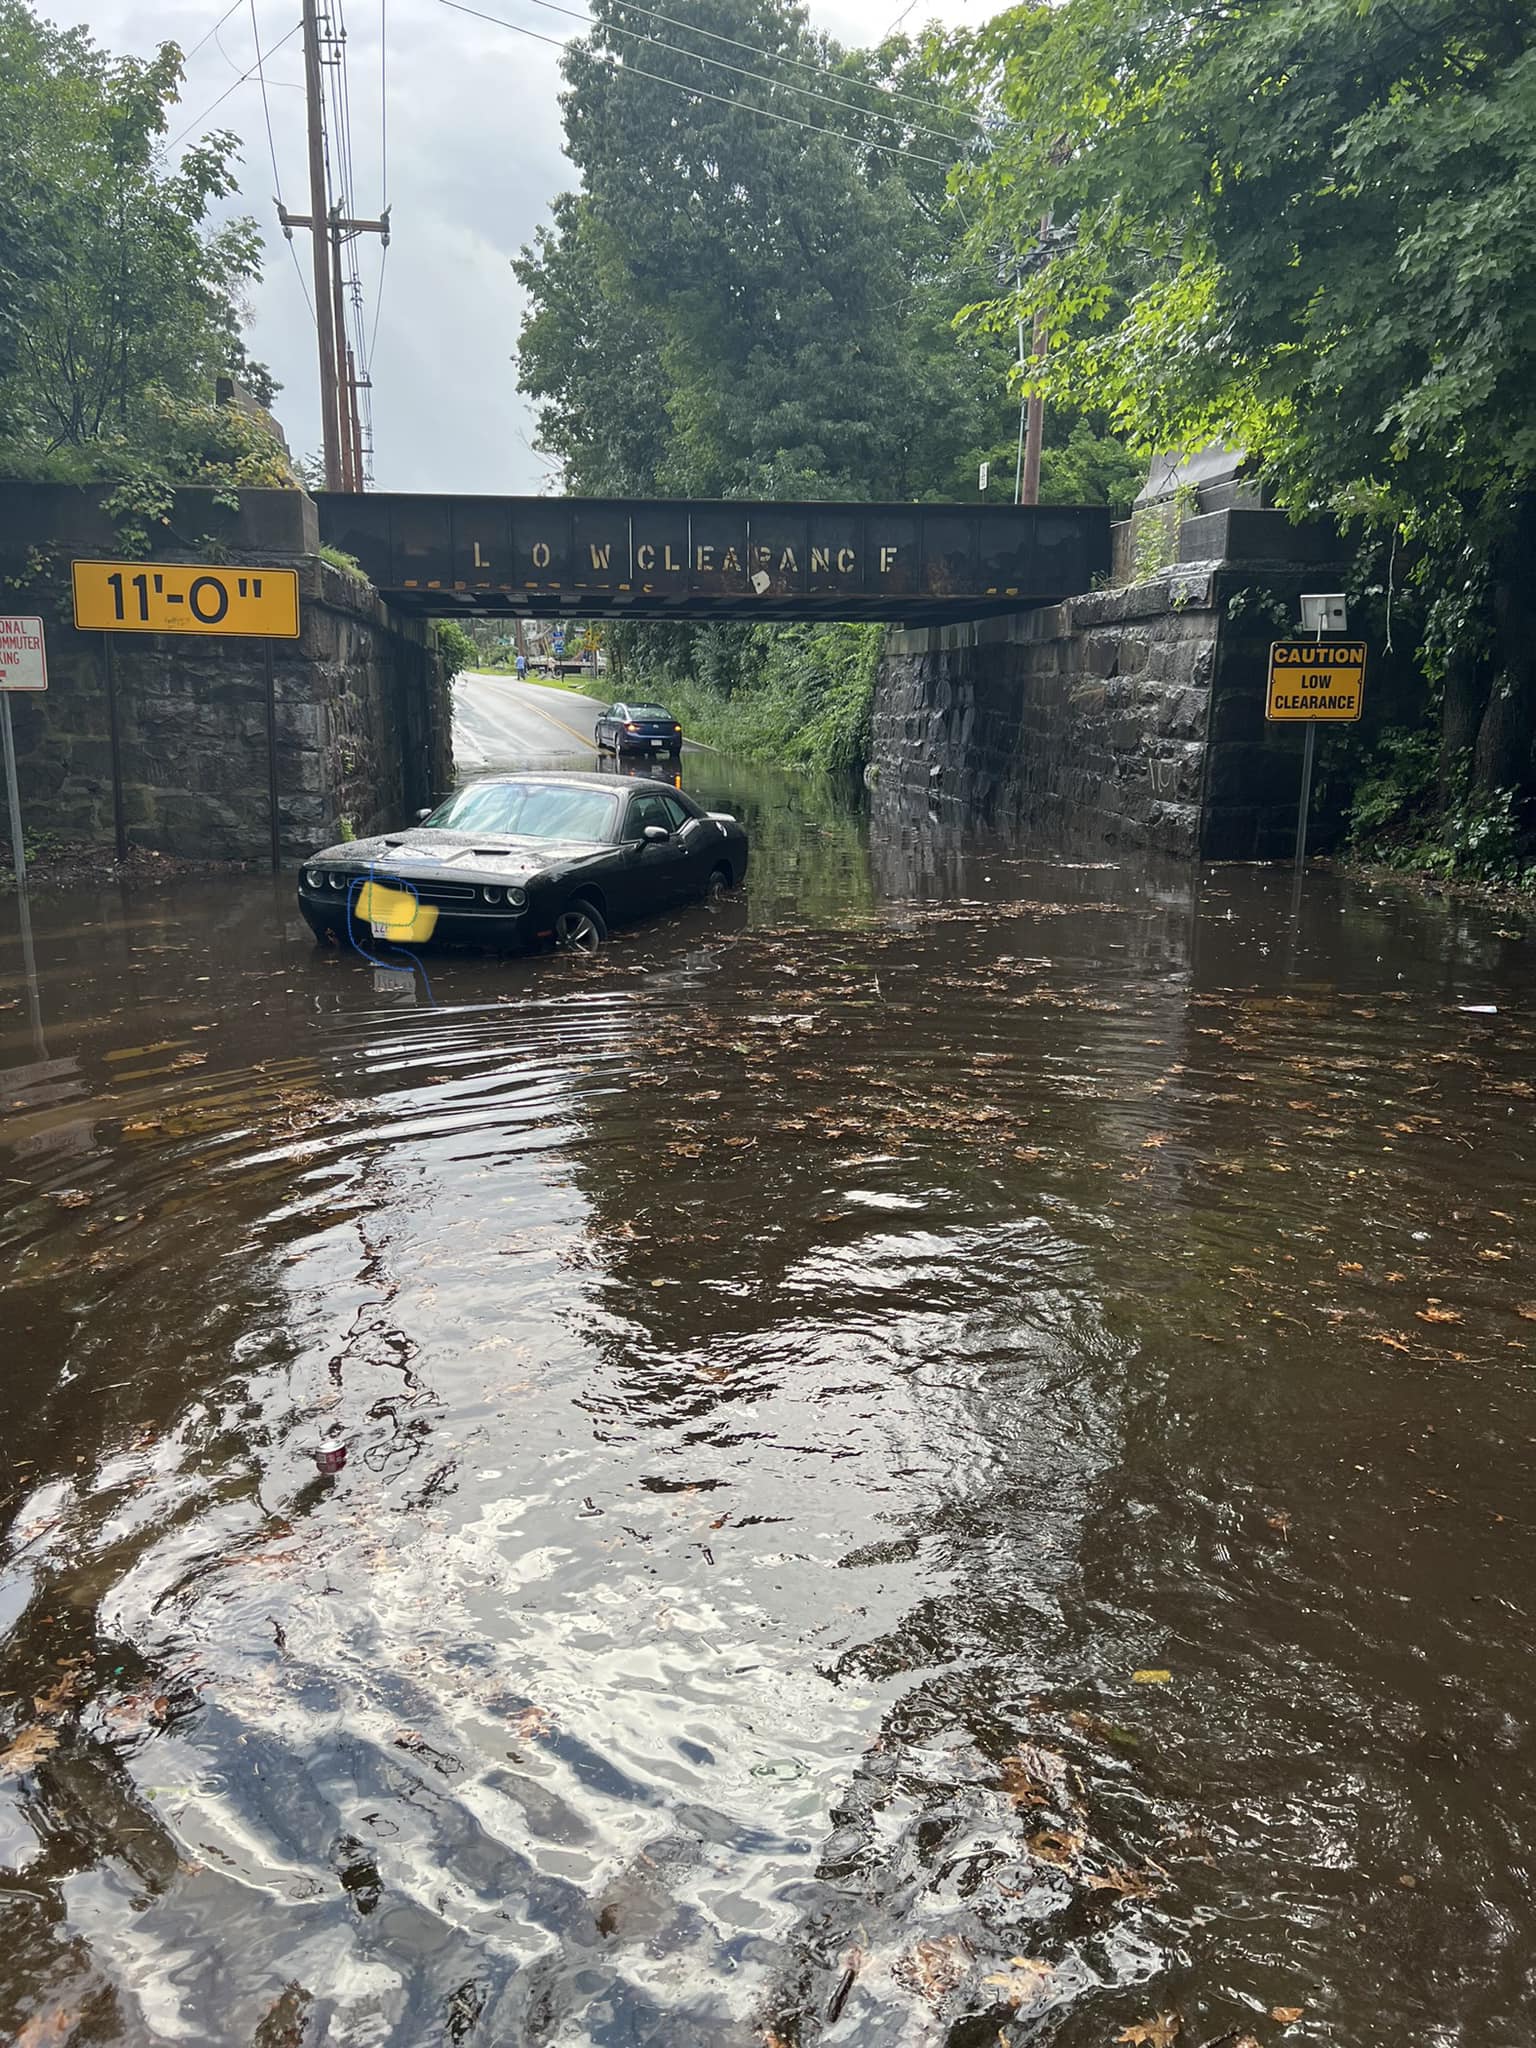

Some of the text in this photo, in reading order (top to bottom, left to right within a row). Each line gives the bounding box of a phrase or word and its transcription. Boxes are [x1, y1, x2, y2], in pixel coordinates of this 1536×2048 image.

[474, 542, 610, 569] LOW
[1274, 648, 1363, 664] CAUTION
[1301, 675, 1332, 689] LOW
[1275, 695, 1355, 709] CLEARANCE
